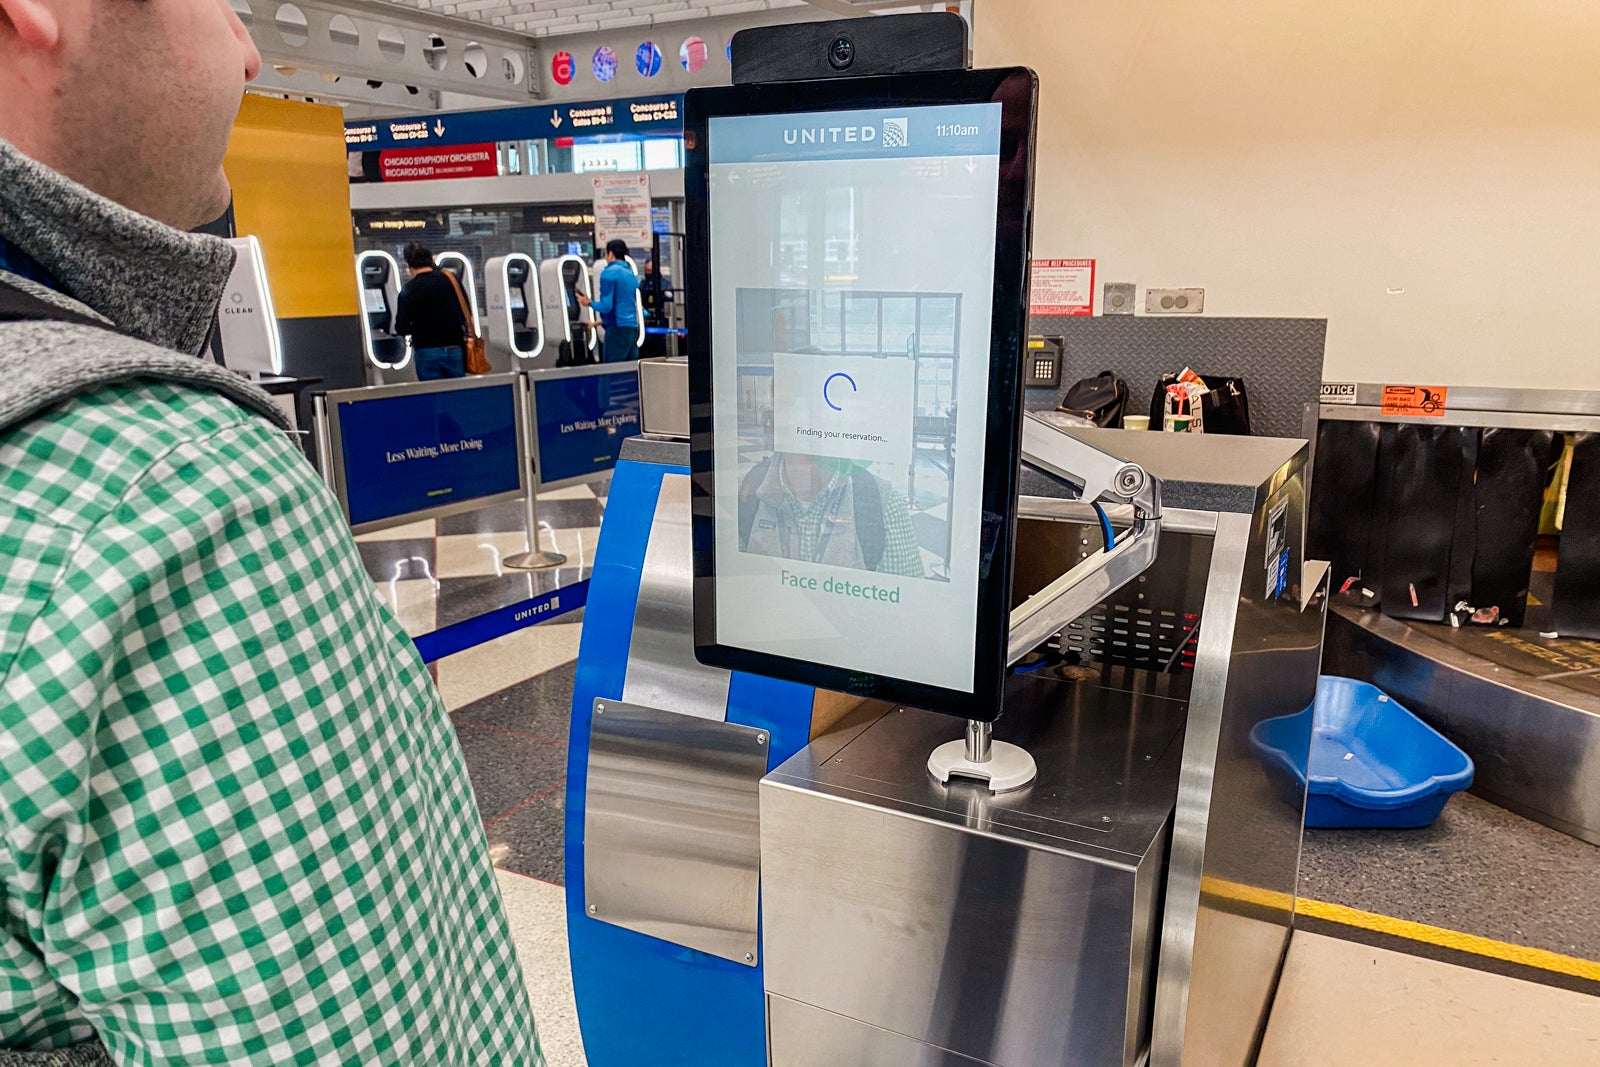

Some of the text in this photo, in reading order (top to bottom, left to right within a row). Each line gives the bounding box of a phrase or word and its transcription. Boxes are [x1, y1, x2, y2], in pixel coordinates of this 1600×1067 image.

[630, 101, 676, 113] Concourse C
[569, 108, 605, 118] Concourse
[633, 113, 652, 122] Gates
[390, 121, 427, 132] Concourse C
[573, 118, 591, 127] Gates
[393, 132, 408, 140] Gates
[783, 125, 876, 145] UNITED
[935, 125, 979, 136] 11:10am
[345, 135, 360, 143] Gates
[384, 152, 490, 166] CHICAGO SYMPHONY ORCHESTRA
[385, 168, 418, 177] RICCARDO
[418, 167, 434, 176] MUTI
[561, 414, 637, 433] Less Waiting, More Exploring
[796, 427, 888, 442] Finding your reservation...
[386, 438, 483, 463] Less Waiting, More Doing
[781, 570, 900, 603] Face detected
[514, 603, 550, 621] UNITED
